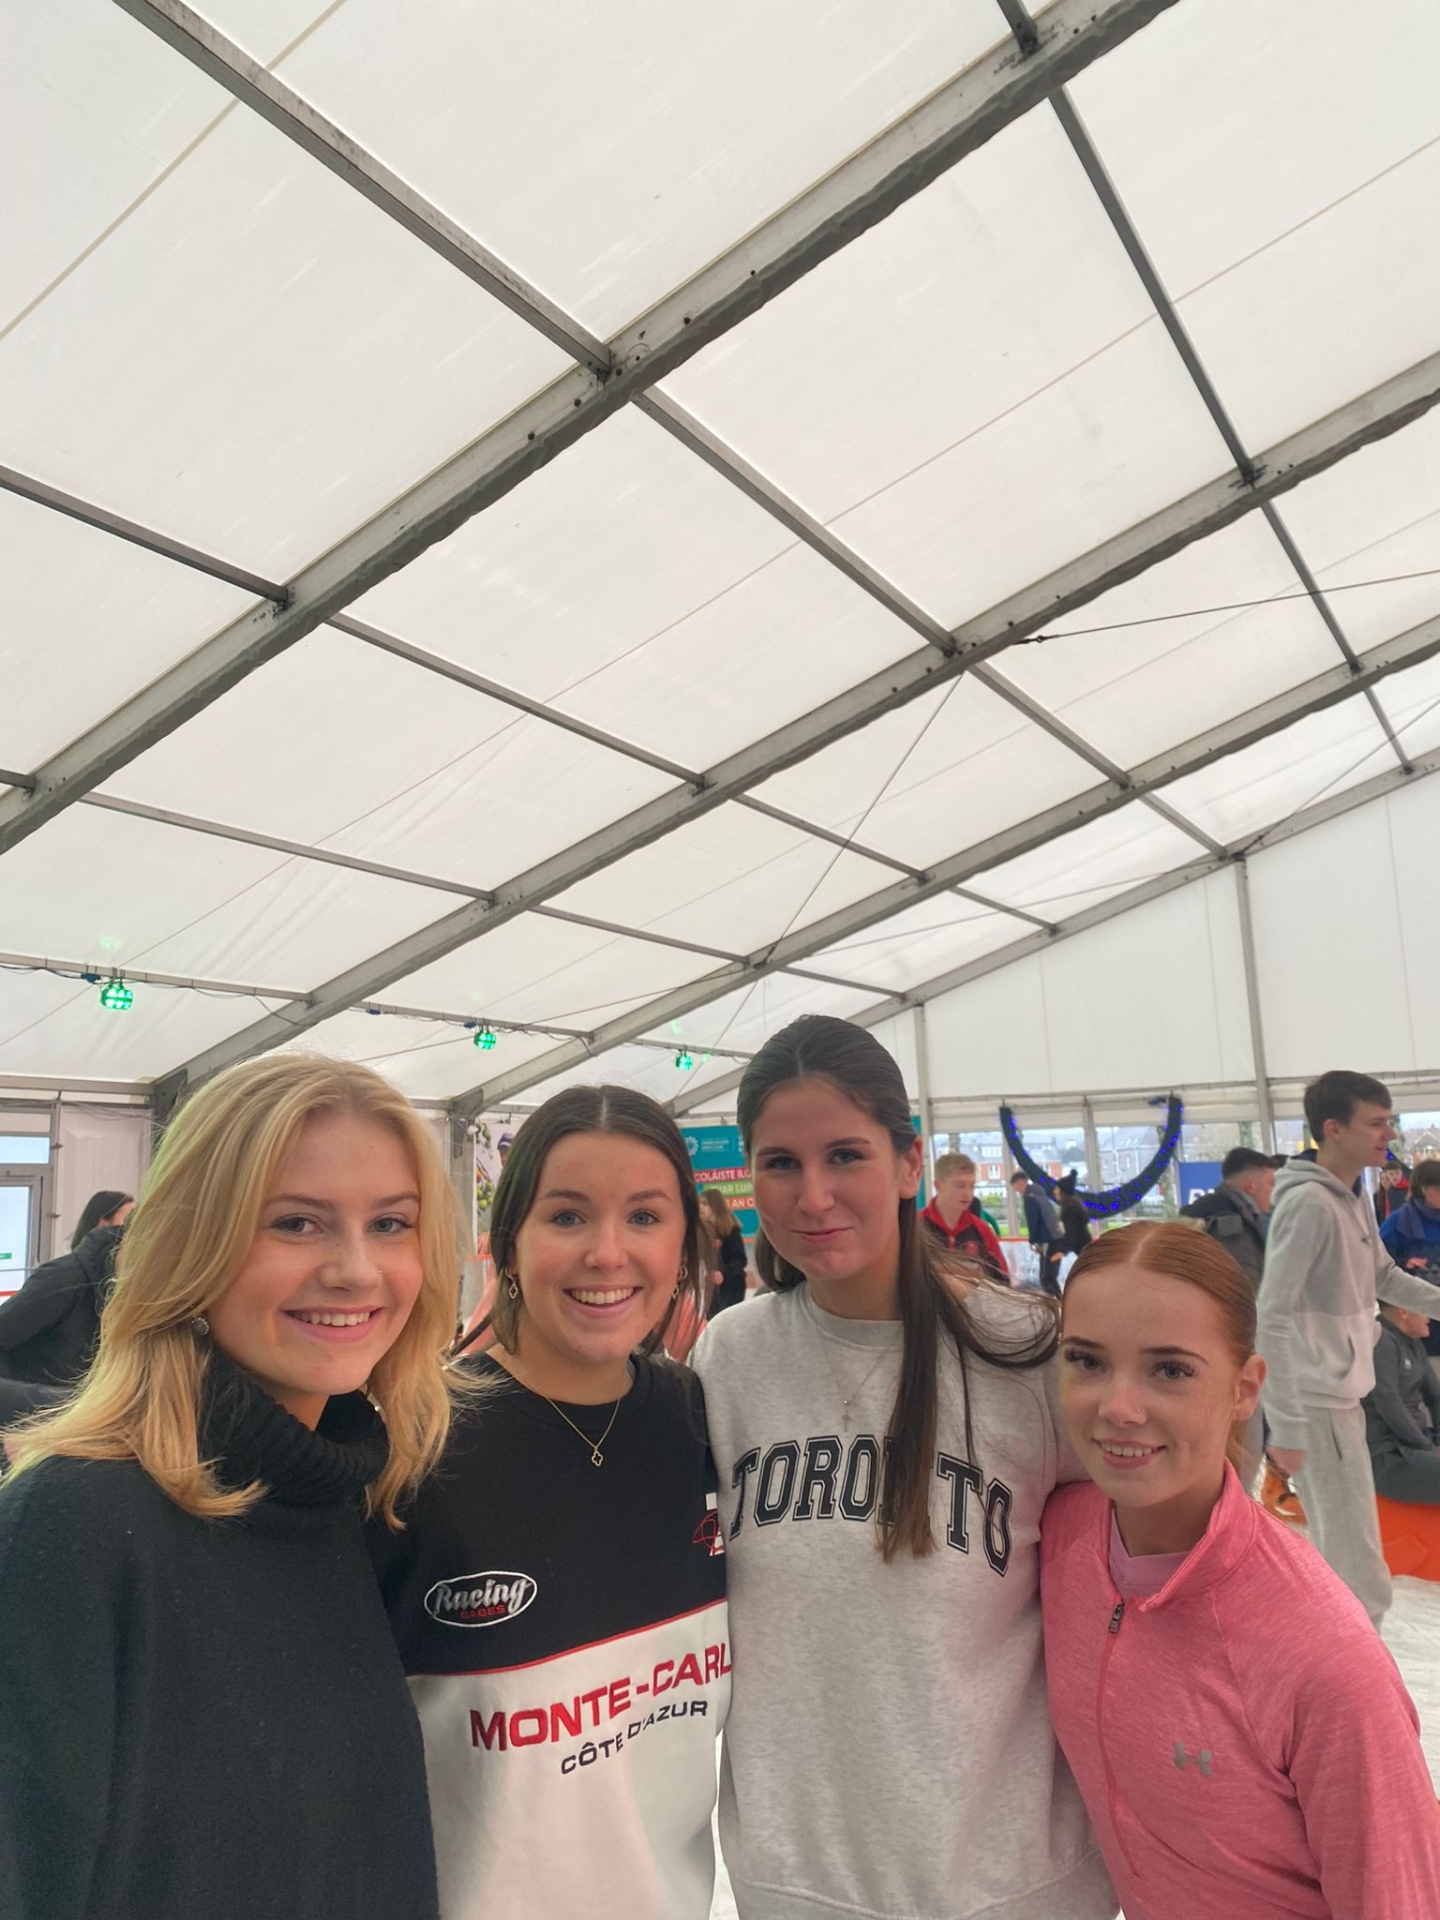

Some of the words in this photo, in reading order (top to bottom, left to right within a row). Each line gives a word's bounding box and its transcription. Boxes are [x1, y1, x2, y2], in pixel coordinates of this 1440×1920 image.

[729, 1434, 1012, 1577] TOROTO
[433, 1579, 533, 1615] Racing
[561, 1732, 624, 1775] CÔTE
[627, 1700, 709, 1740] D'AZUR
